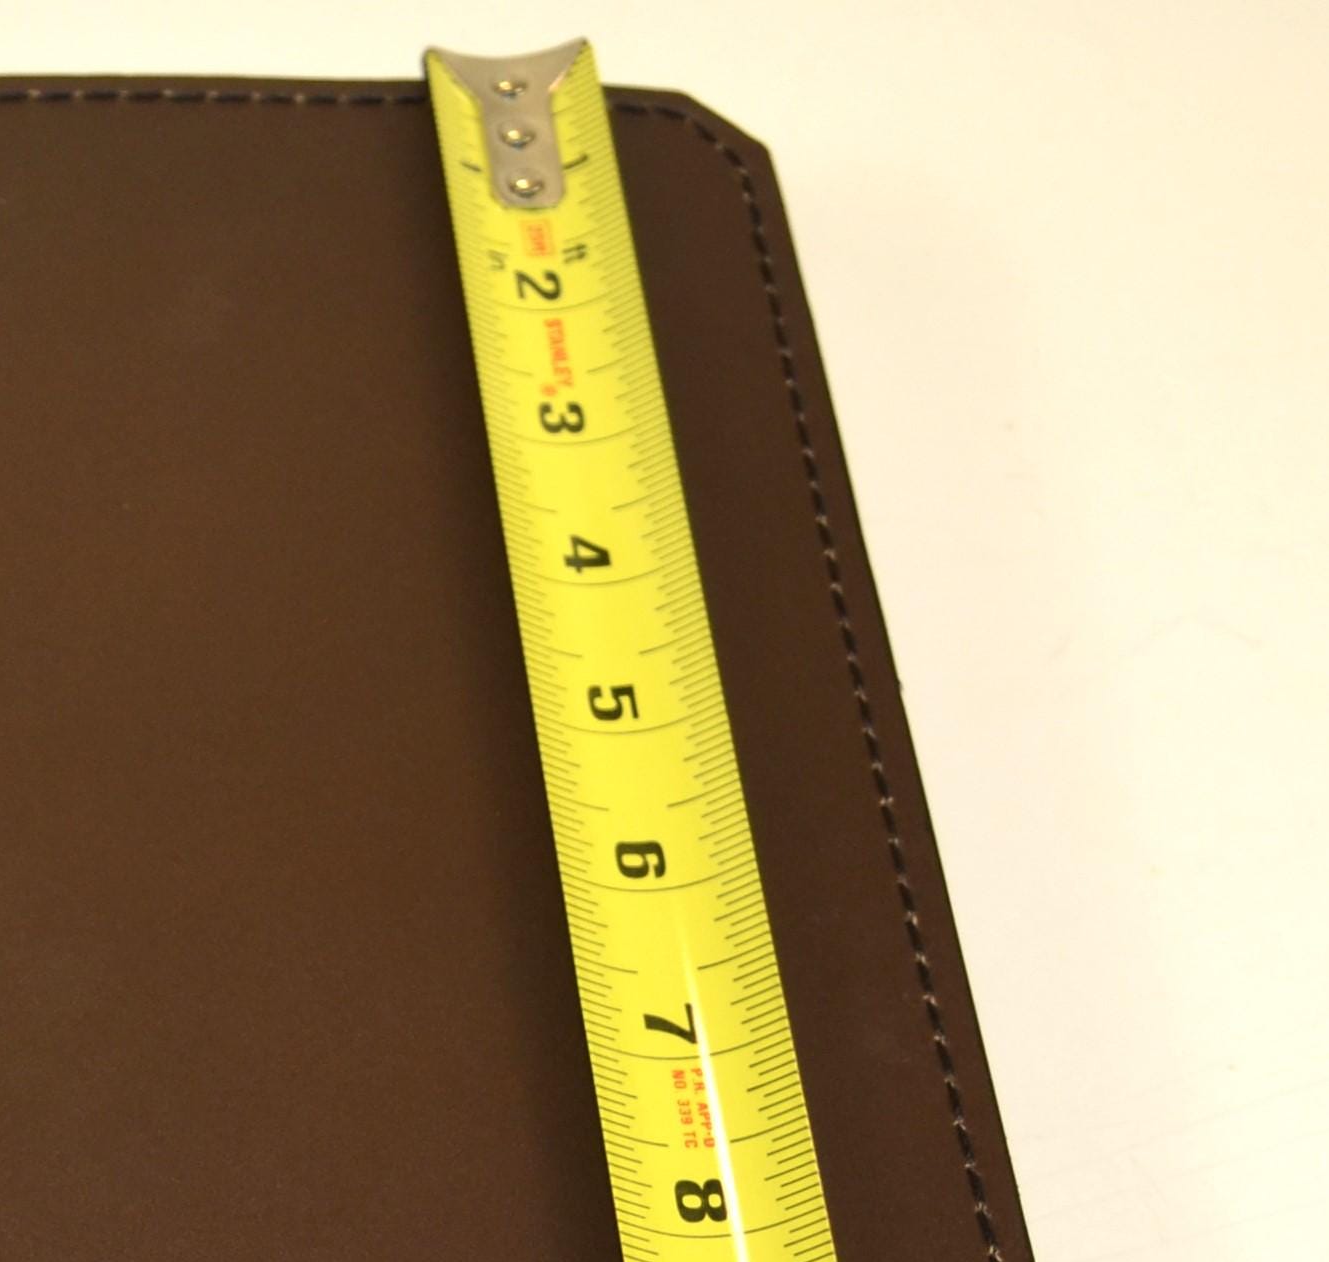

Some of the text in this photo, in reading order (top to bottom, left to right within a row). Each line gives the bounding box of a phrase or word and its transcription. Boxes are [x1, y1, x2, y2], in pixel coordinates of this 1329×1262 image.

[515, 270, 561, 301] 2
[539, 402, 585, 434] 3
[564, 534, 611, 574] 4
[587, 684, 638, 721] 5
[615, 841, 665, 879] 6
[643, 1003, 697, 1044] 7
[674, 1178, 727, 1223] 8
